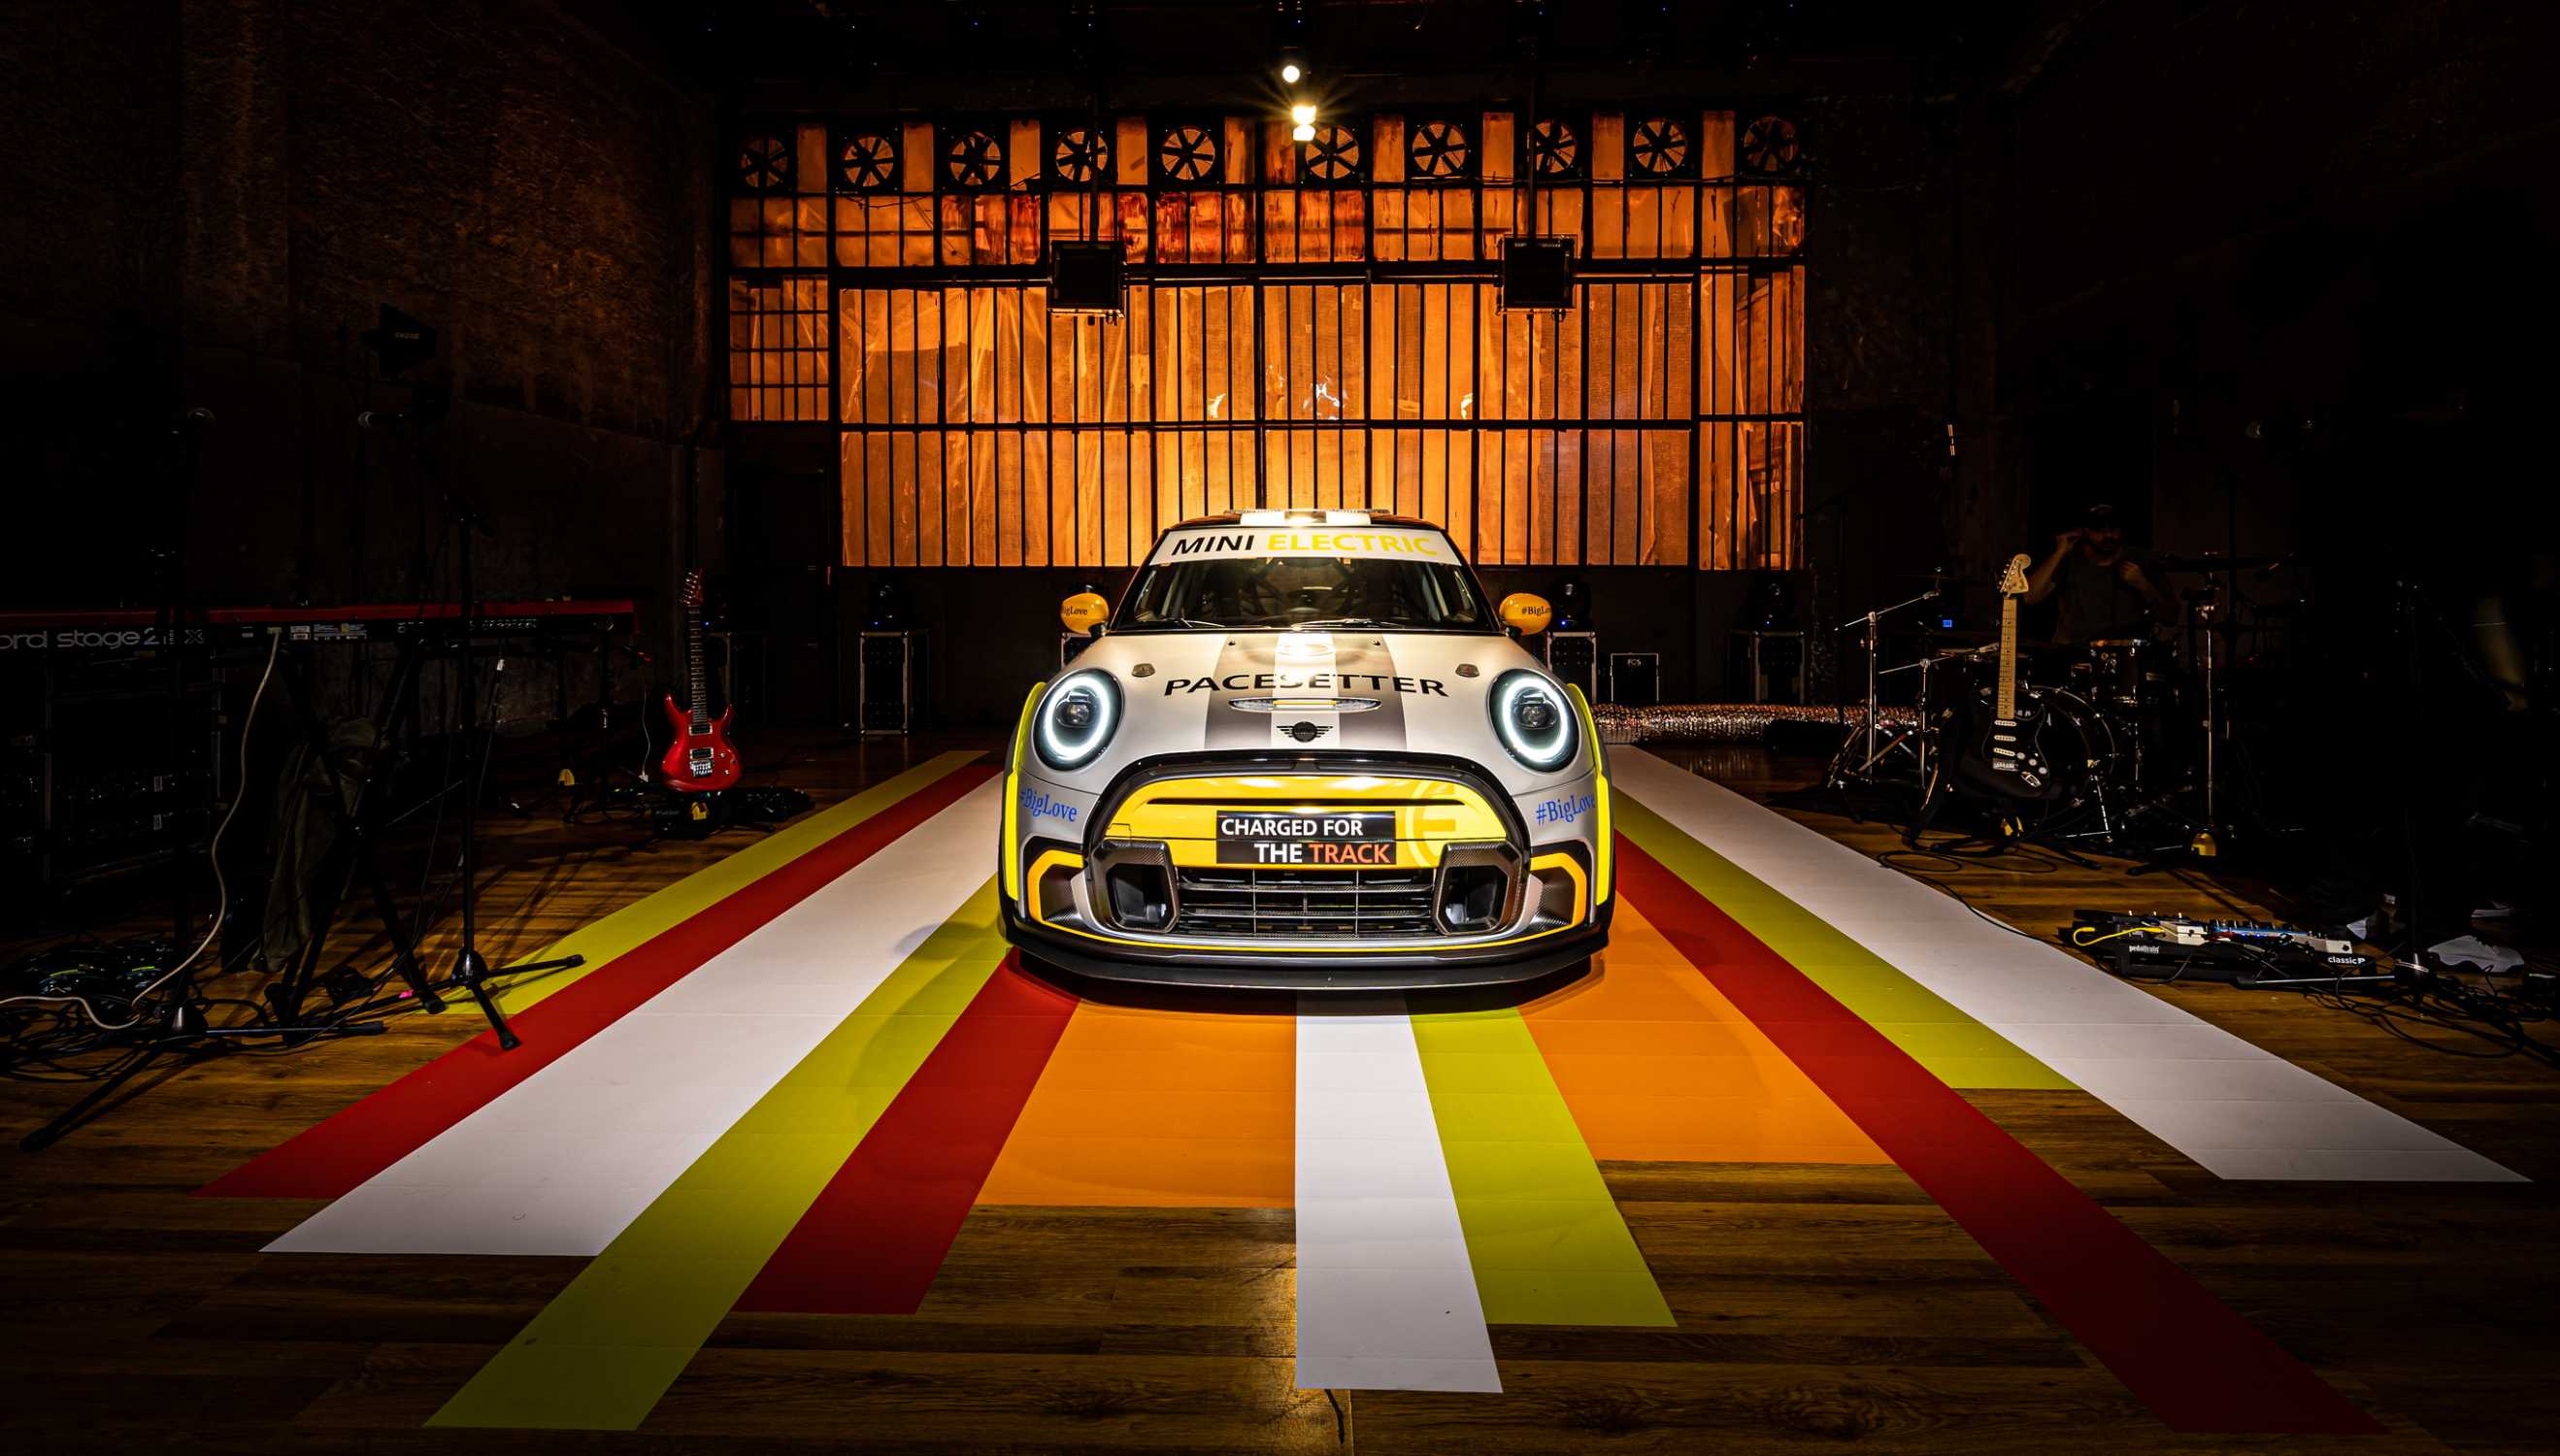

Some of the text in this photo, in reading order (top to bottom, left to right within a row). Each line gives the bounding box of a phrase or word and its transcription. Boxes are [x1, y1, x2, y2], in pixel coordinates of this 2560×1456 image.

[1171, 534, 1438, 556] MINI ELECTRIC
[1164, 673, 1450, 698] PACESETTER
[1220, 818, 1364, 837] CHARGED FOR
[1253, 843, 1391, 864] THE TRACK
